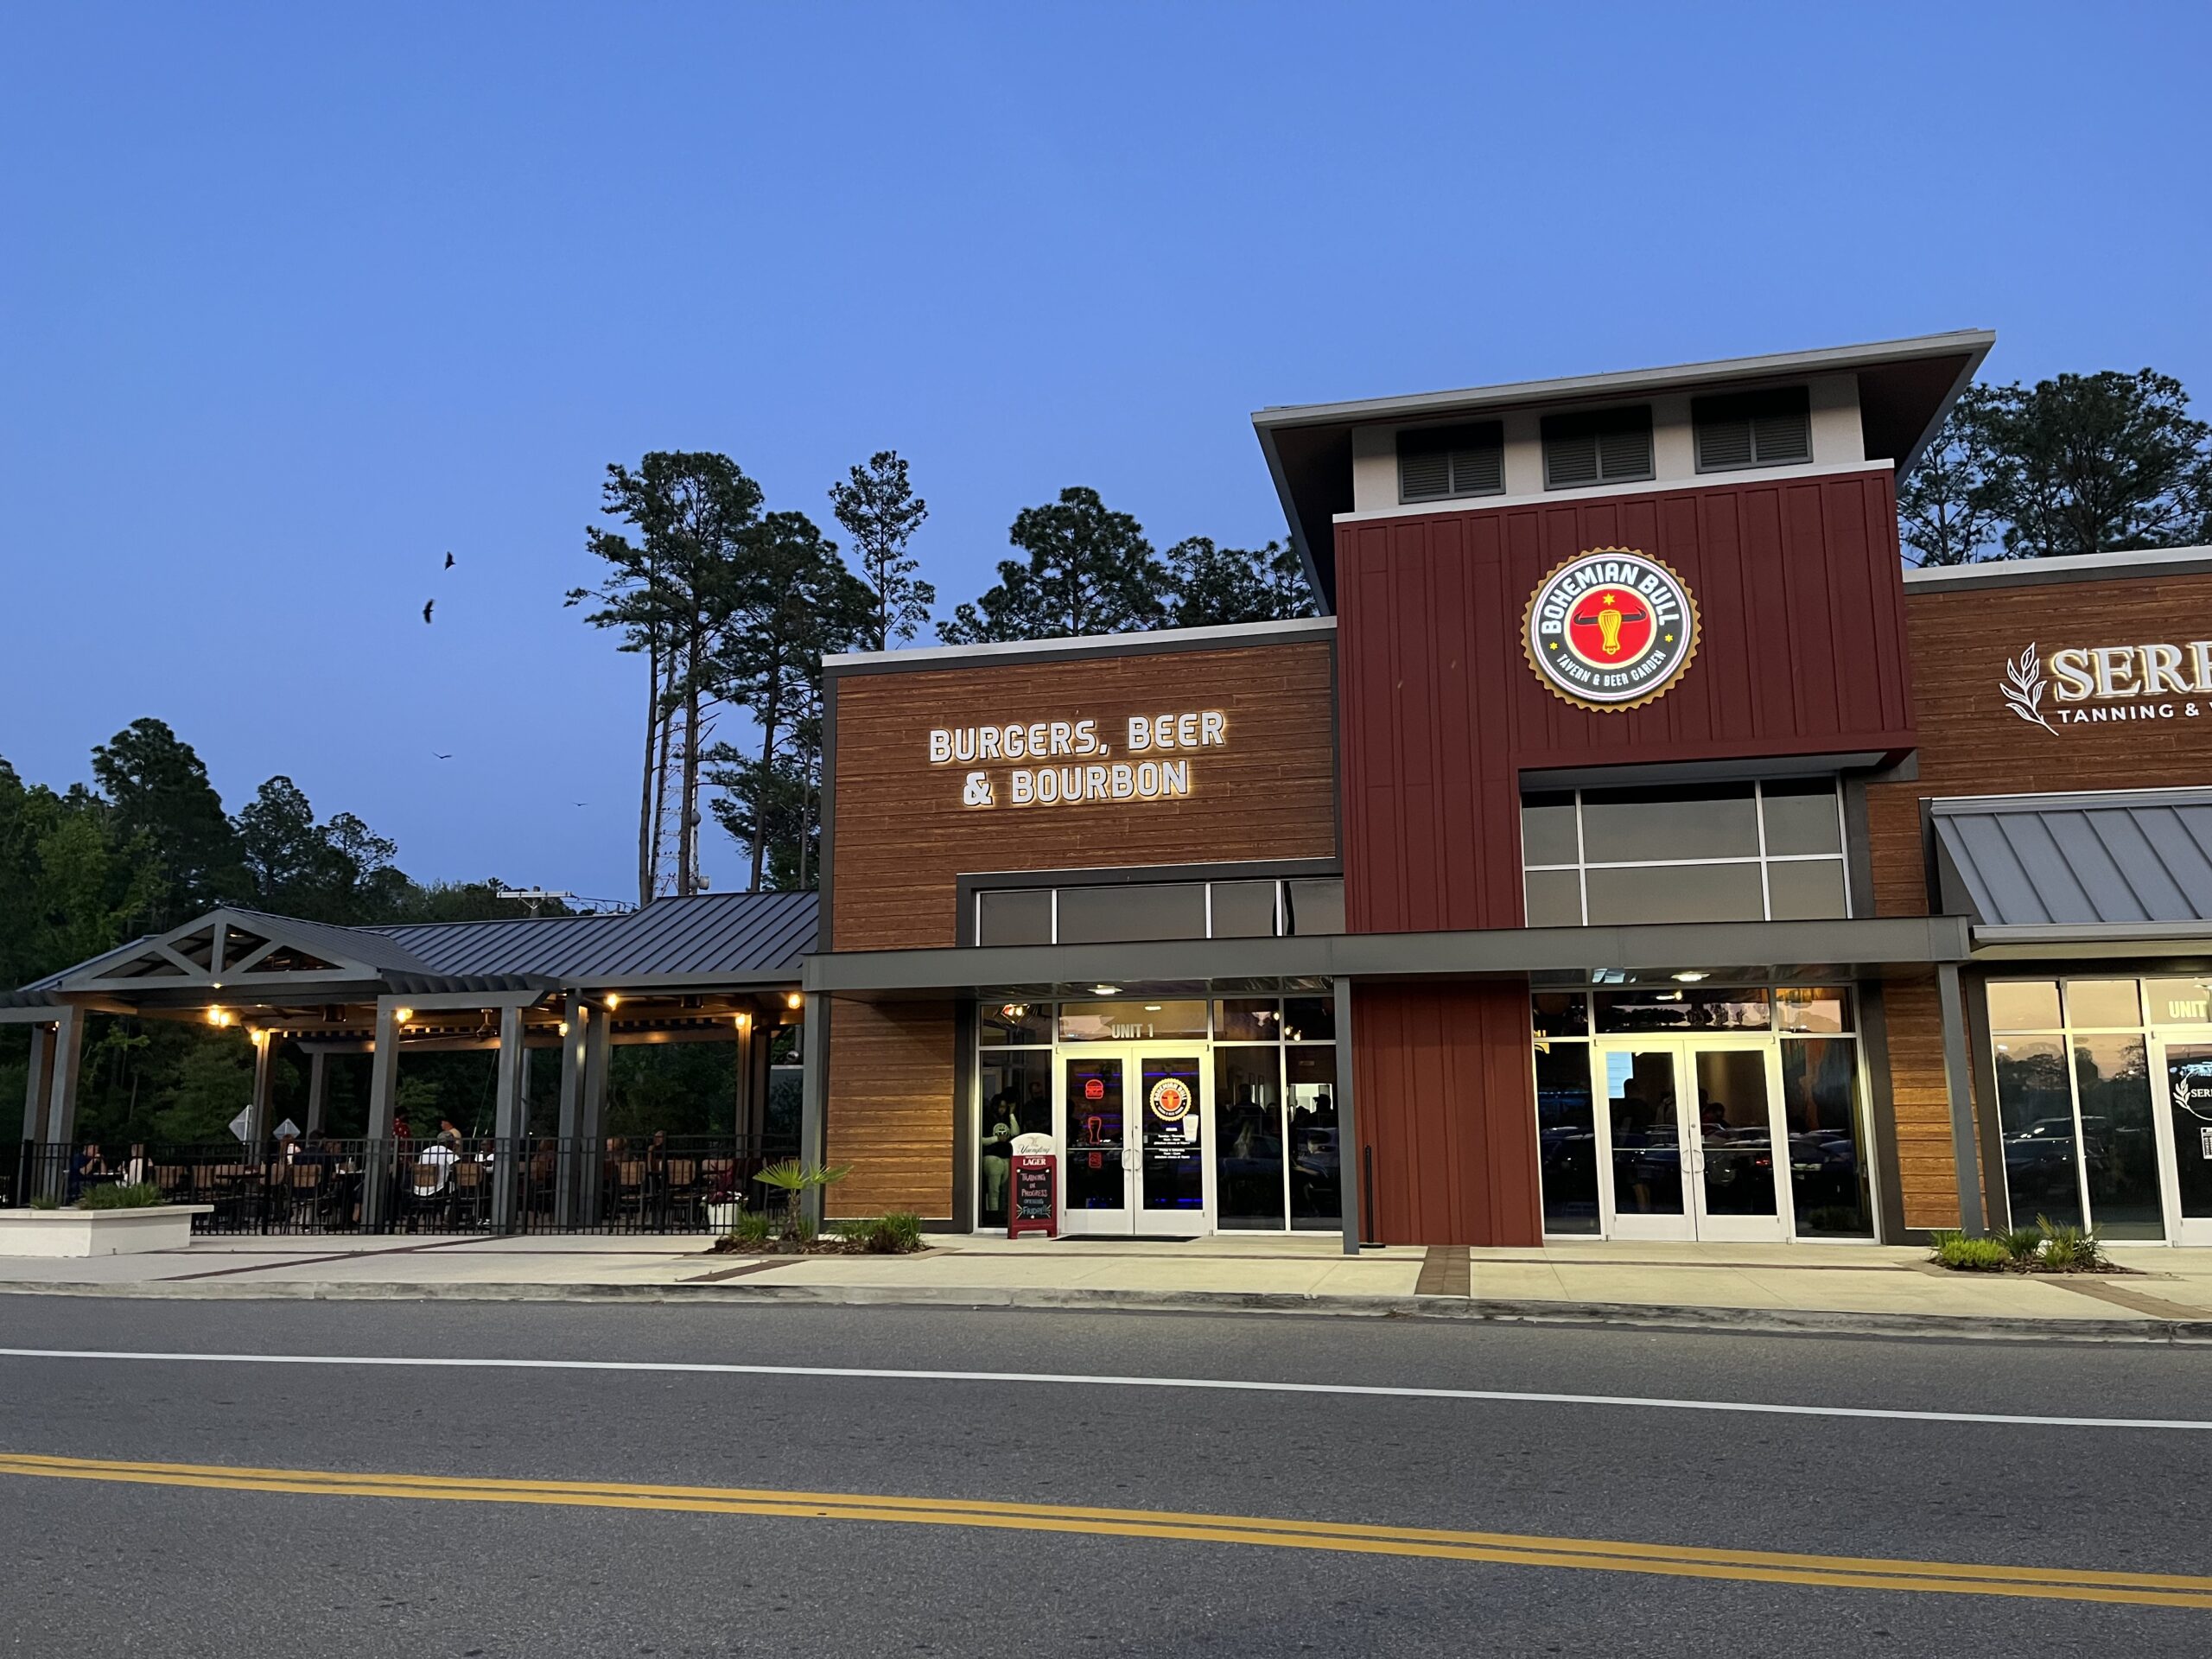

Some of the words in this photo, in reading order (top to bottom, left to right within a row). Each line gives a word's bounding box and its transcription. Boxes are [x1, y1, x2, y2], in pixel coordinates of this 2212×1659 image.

[1541, 563, 1639, 633] BOHEMIAN
[1637, 574, 1680, 626] BULL
[1556, 653, 1592, 683] TAVERN
[1592, 674, 1600, 686] &
[1604, 673, 1629, 687] BEER
[1630, 650, 1667, 681] GARDEN
[2057, 703, 2174, 723] TANNING
[2185, 702, 2199, 717] &
[929, 720, 1110, 763] BURGERS,
[1128, 712, 1225, 750] BEER
[963, 772, 993, 806] &
[1011, 760, 1188, 804] BOURBON
[2168, 1000, 2208, 1019] UNIT
[1111, 1023, 1143, 1039] UNIT
[1147, 1023, 1154, 1038] 1
[2190, 1089, 2212, 1097] SER
[1022, 1158, 1046, 1166] LAGER
